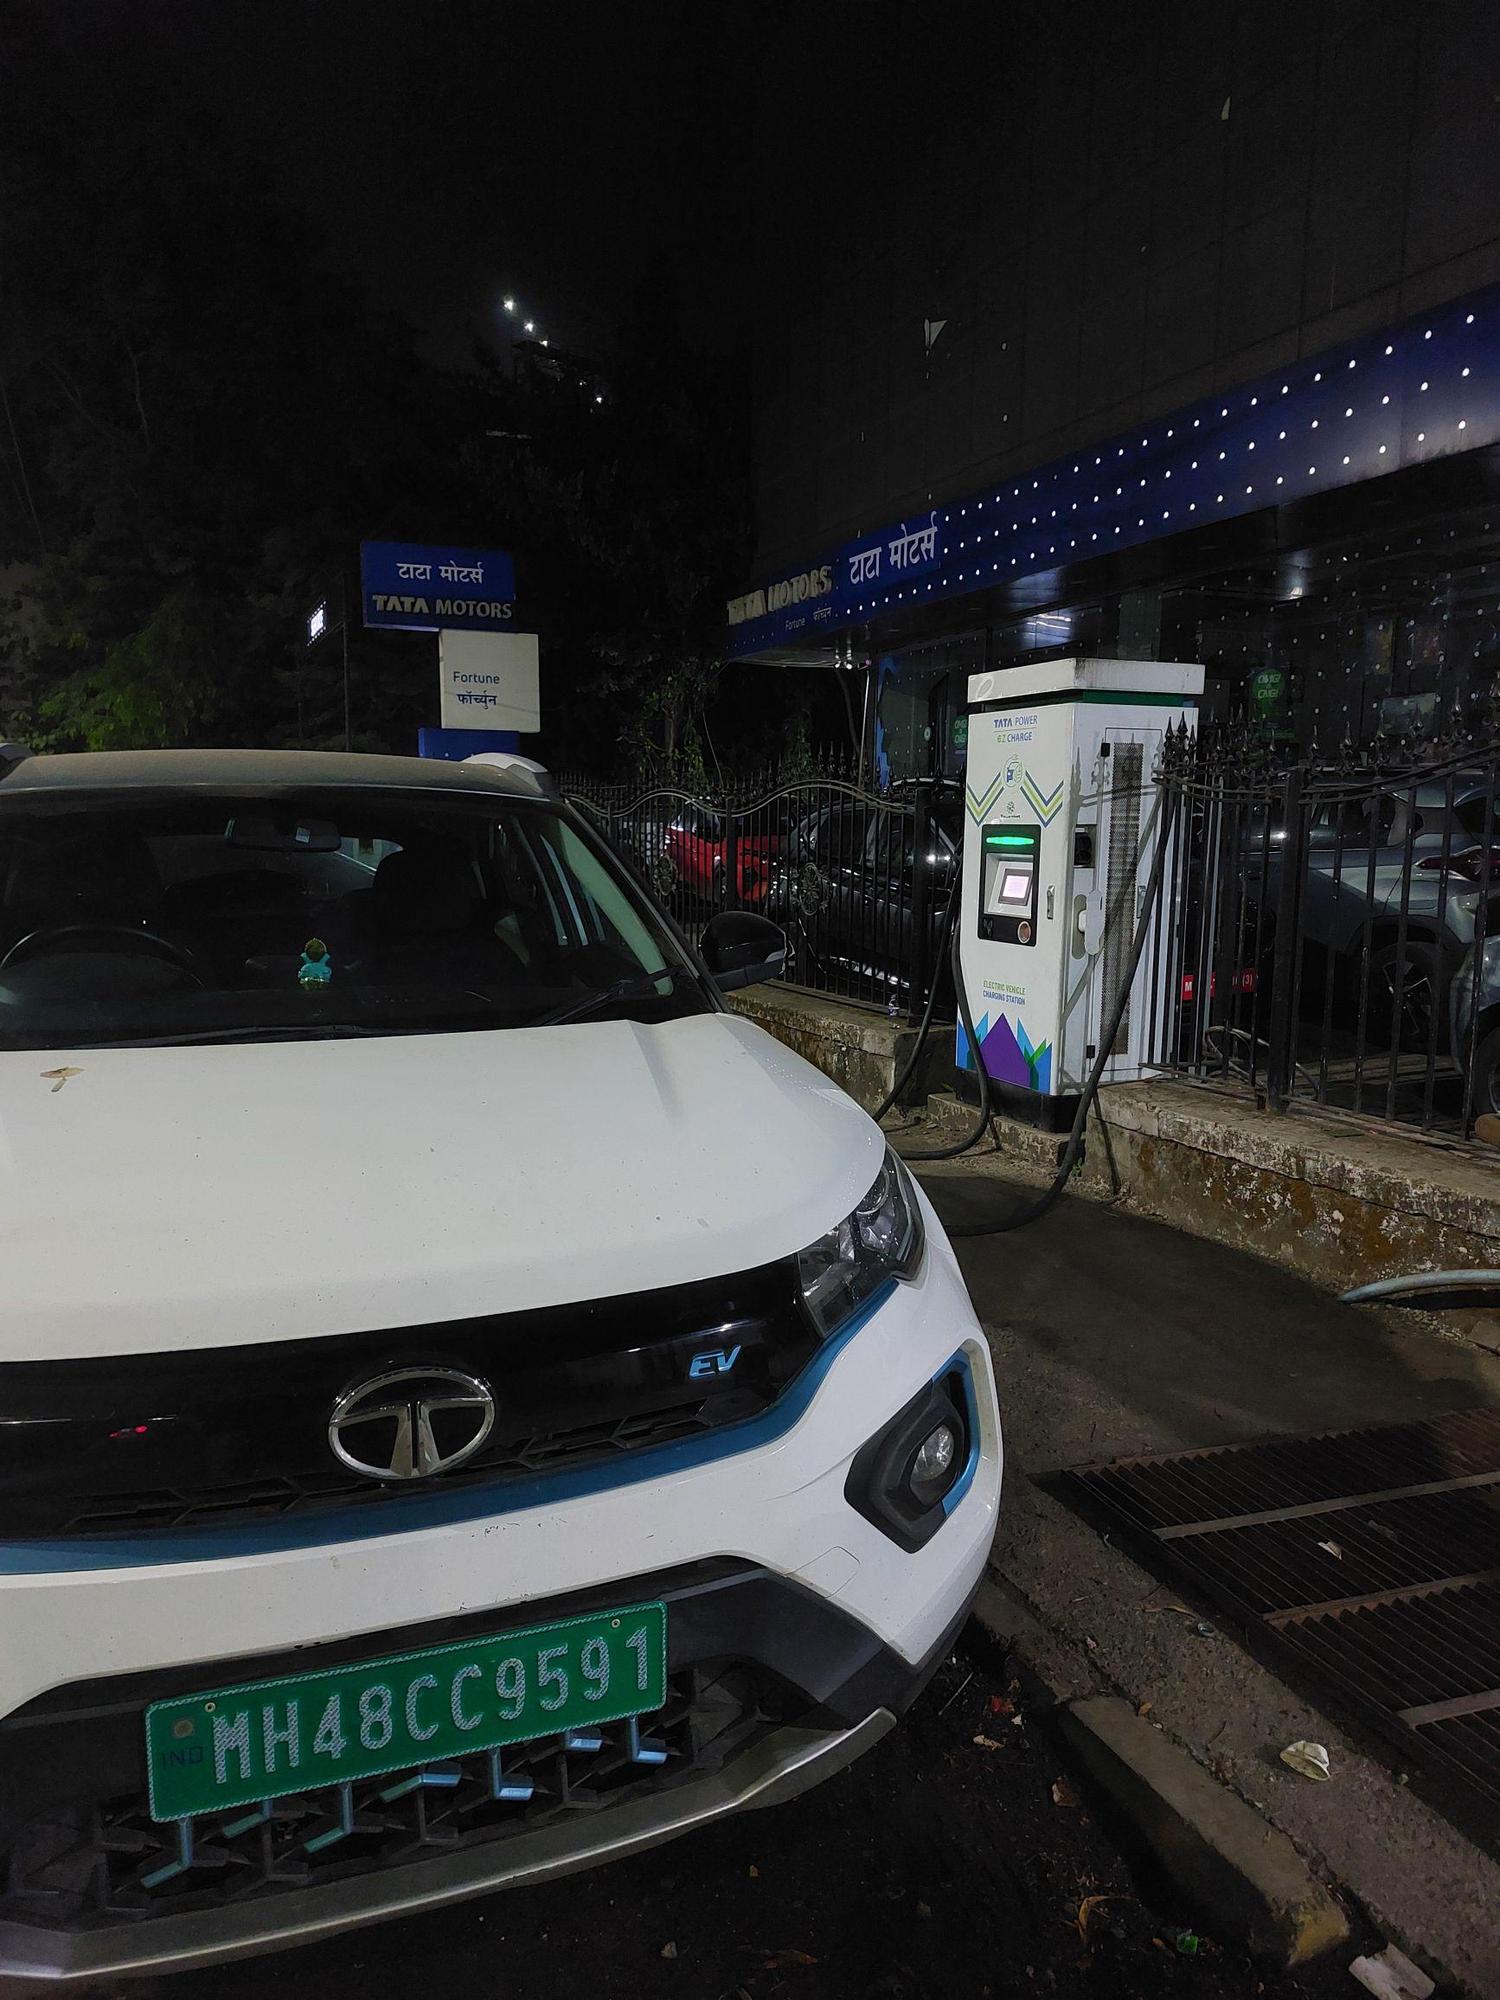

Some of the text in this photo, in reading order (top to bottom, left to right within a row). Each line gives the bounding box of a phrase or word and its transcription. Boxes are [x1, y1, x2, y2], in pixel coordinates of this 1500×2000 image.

[850, 510, 939, 584] टाटा मोटर्स
[396, 560, 484, 584] टाटा मोटर्स
[767, 565, 833, 613] MOTORS
[372, 594, 512, 619] TATA MOTORS
[453, 671, 500, 684] Fortune
[994, 715, 1038, 728] TATA POWER
[1007, 732, 1033, 743] CHARGE
[982, 989, 1026, 1005] CHARGING STATION
[983, 980, 1026, 996] ELECTRIC VEHICLE
[688, 1345, 742, 1379] EV
[161, 1746, 204, 1770] IND
